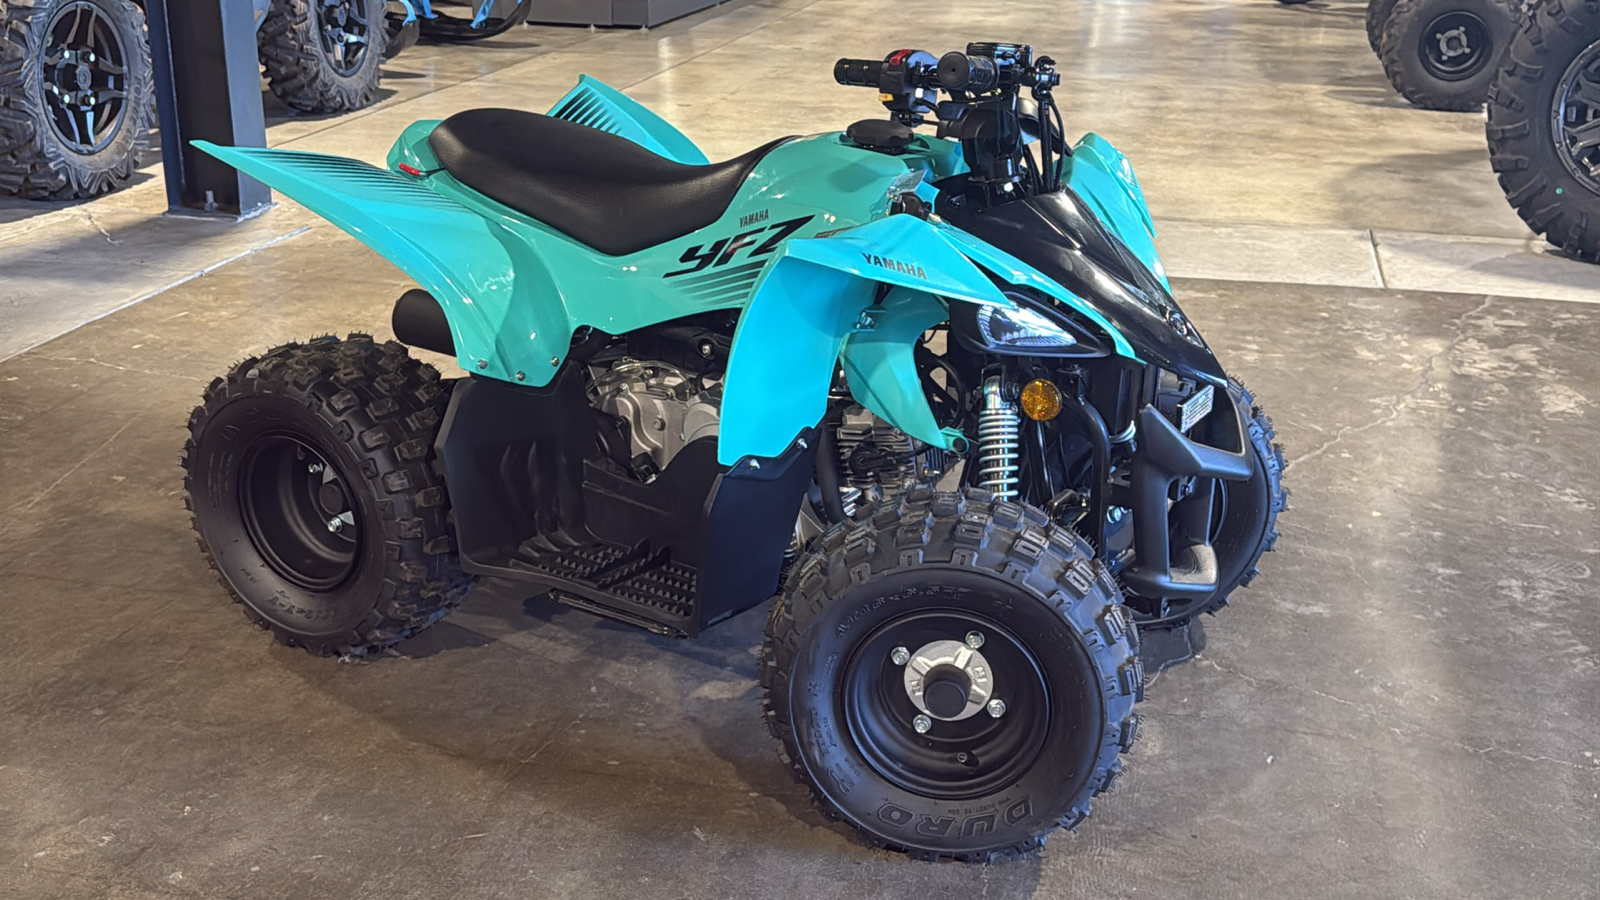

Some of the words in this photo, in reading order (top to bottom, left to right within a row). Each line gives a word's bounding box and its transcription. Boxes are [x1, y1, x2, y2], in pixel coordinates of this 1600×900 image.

[739, 208, 770, 228] YAMAHA
[861, 252, 927, 280] YAMAHA
[877, 795, 1033, 839] DURO
